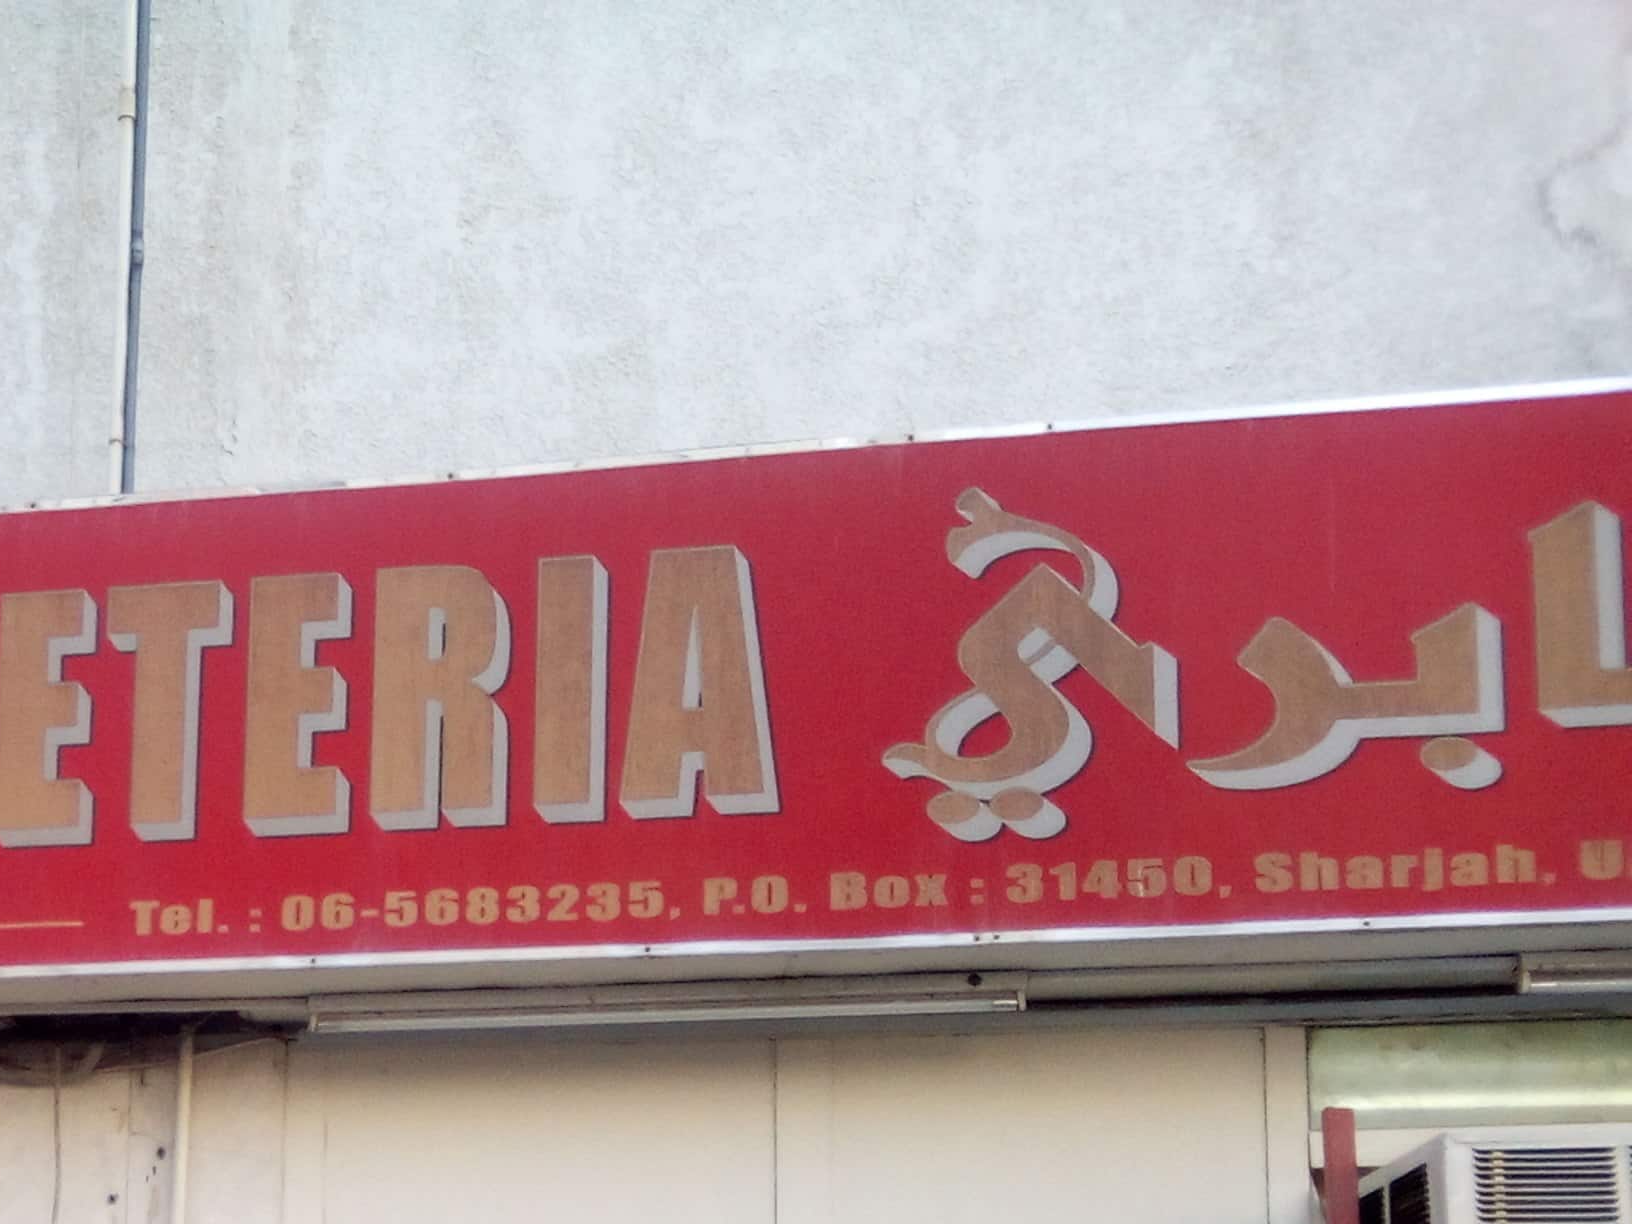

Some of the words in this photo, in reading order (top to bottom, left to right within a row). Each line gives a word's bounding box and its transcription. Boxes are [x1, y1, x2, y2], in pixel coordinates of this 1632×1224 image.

[281, 880, 680, 931] 06-5683235,
[703, 876, 806, 915] P.O.
[830, 872, 948, 910] Box
[1006, 856, 1231, 902] 31450,
